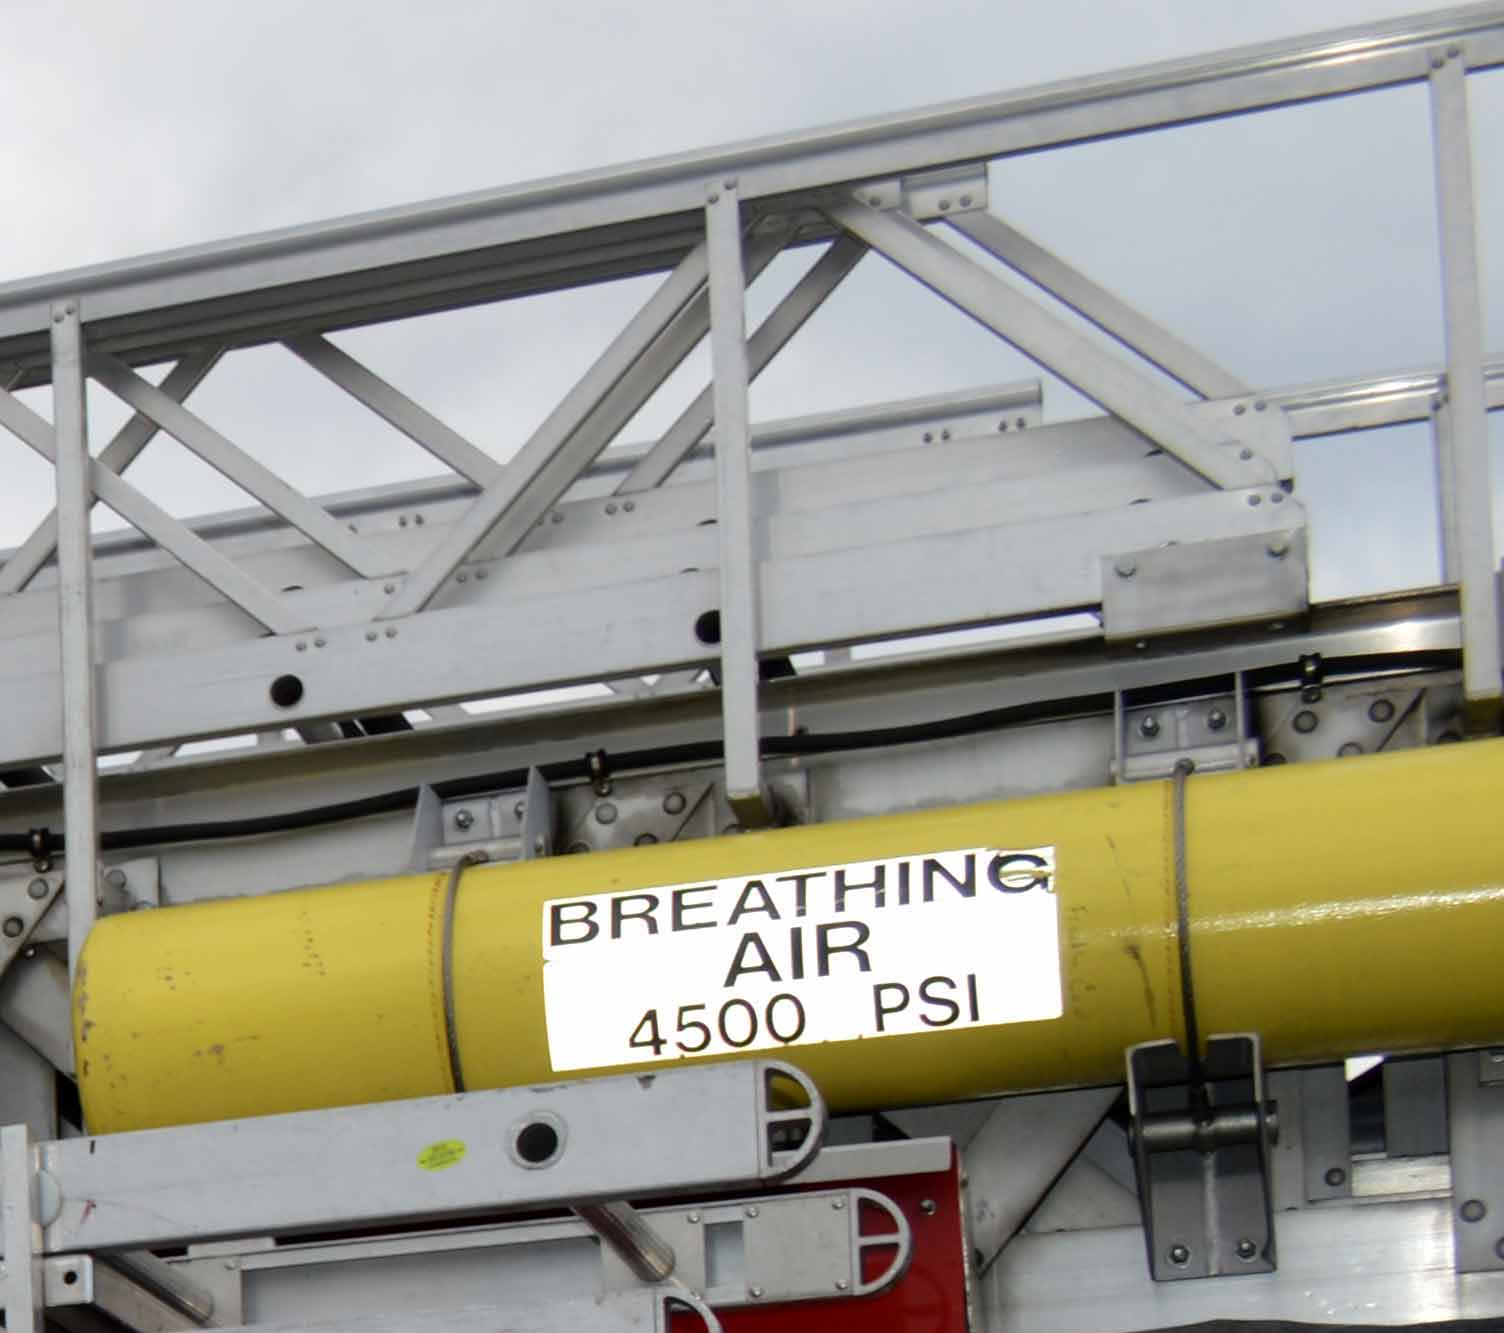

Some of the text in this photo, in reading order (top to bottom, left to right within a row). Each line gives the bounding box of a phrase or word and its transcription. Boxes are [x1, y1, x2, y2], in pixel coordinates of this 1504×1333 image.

[549, 852, 1054, 947] BREATHING
[723, 919, 871, 988] AIR
[628, 972, 981, 1056] 4500 PSI
